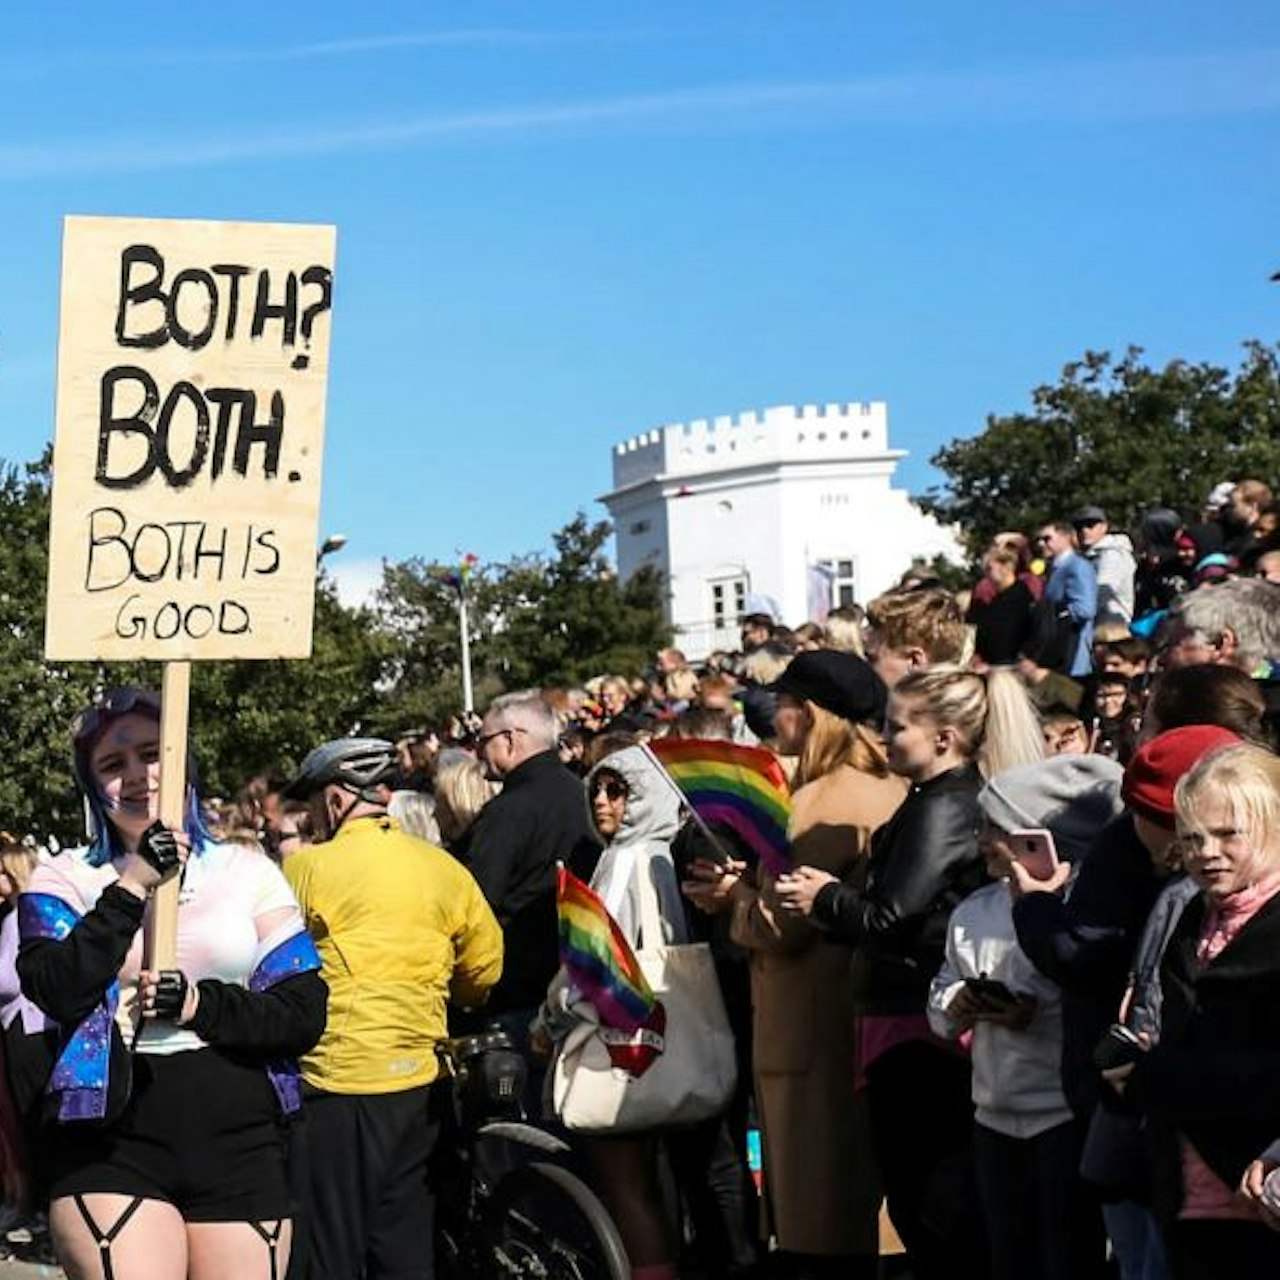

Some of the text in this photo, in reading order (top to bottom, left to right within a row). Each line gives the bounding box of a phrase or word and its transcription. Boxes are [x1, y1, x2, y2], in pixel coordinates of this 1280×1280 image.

[116, 244, 335, 371] BOTH?
[94, 365, 302, 491] BOTH.
[84, 506, 281, 593] BOTH IS
[114, 594, 252, 640] GOOD
